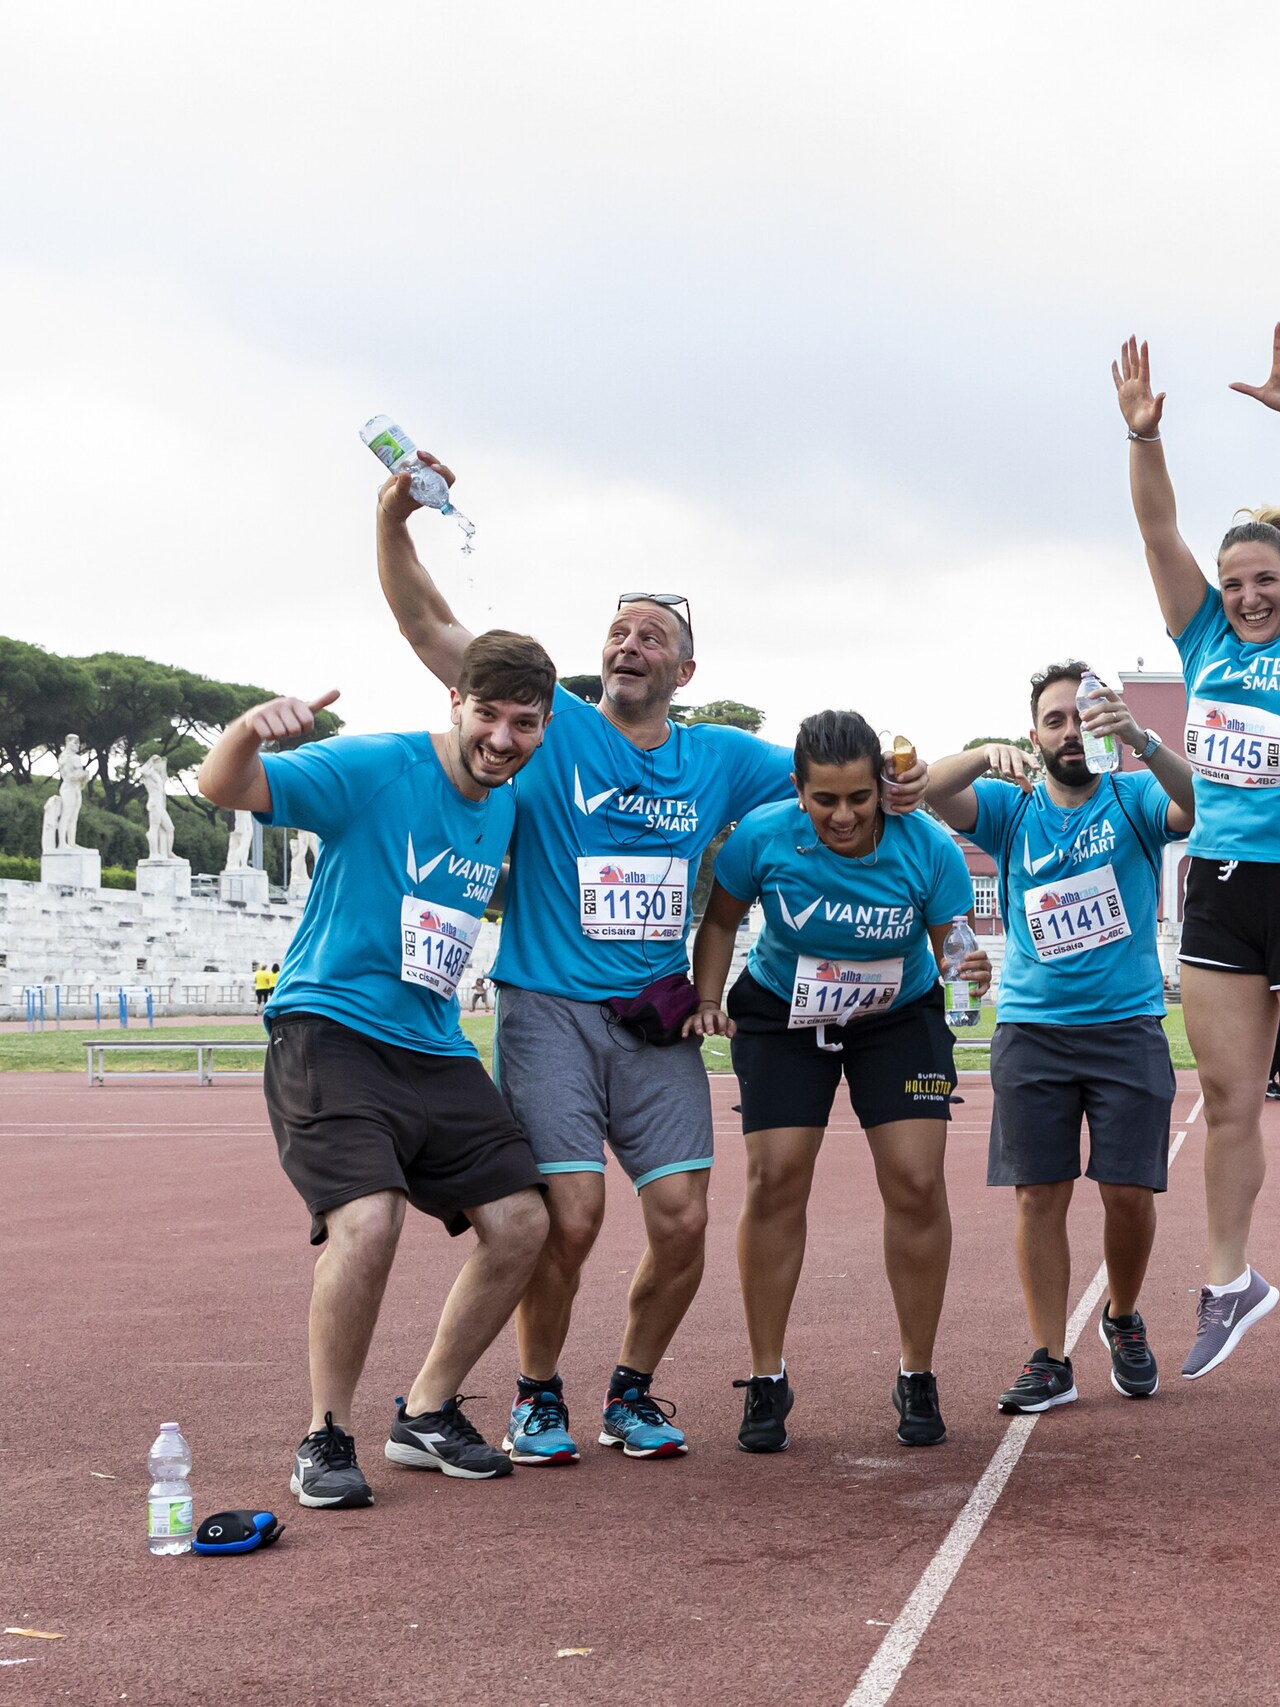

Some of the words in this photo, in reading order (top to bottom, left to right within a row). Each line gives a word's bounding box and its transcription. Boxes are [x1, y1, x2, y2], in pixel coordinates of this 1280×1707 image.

[1204, 733, 1262, 769] 1145
[618, 795, 697, 817] VANTEA
[645, 815, 699, 832] SMART
[1072, 835, 1116, 866] SMART
[603, 889, 666, 921] 1130
[825, 901, 914, 926] VANTEA
[854, 921, 913, 940] SMART
[1047, 901, 1105, 939] 1141
[422, 935, 463, 978] 1148
[815, 985, 876, 1012] 1144
[904, 1080, 952, 1095] HOLLISTER
[917, 1072, 946, 1080] SURFING
